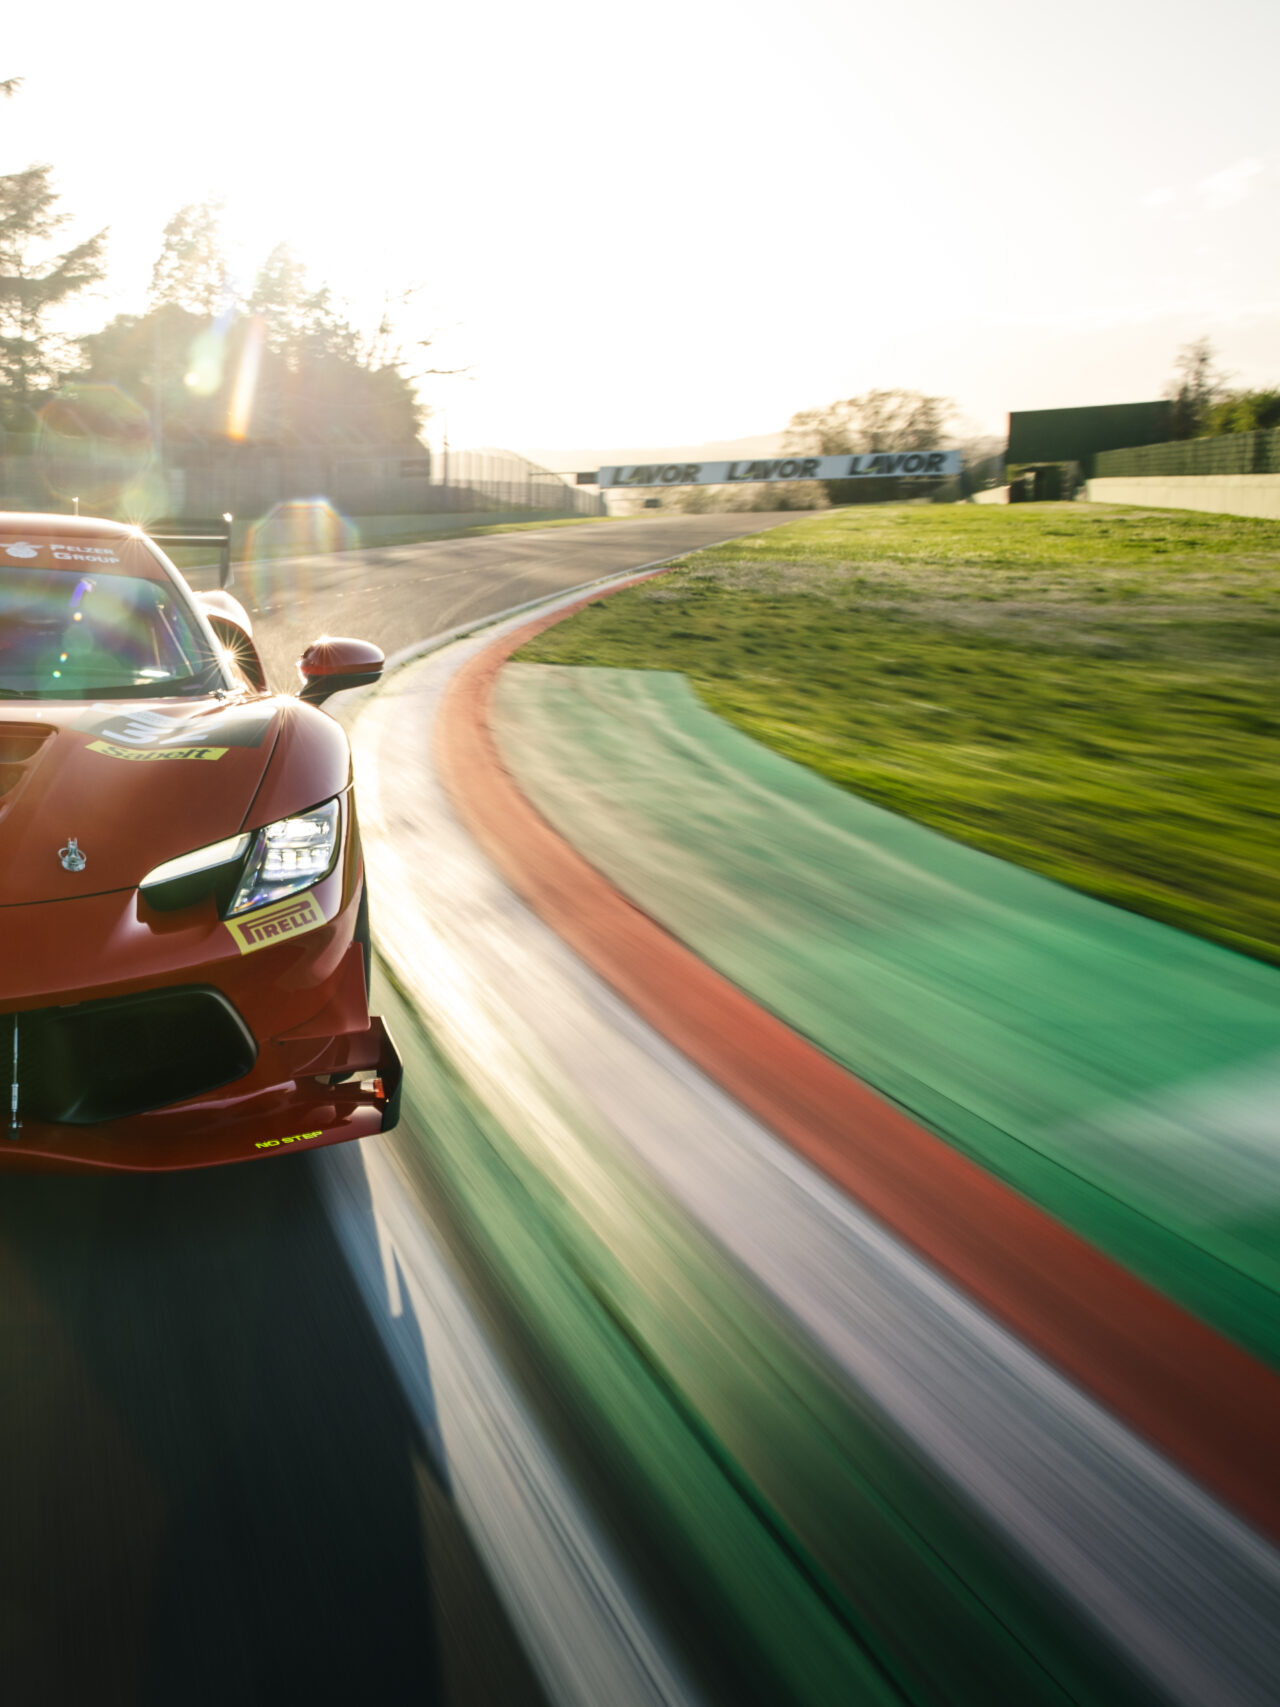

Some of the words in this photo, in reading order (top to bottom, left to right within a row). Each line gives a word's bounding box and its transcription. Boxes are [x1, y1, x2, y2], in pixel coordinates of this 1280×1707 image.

[612, 464, 701, 485] LAVOR
[726, 459, 822, 481] LAVOR
[847, 452, 947, 476] LAVOR
[50, 544, 115, 556] PELZER
[53, 552, 120, 564] GROUP
[101, 746, 211, 759] Sabelt
[237, 900, 318, 945] PIRELLI
[255, 1140, 280, 1149] NO
[281, 1130, 323, 1144] STEP
